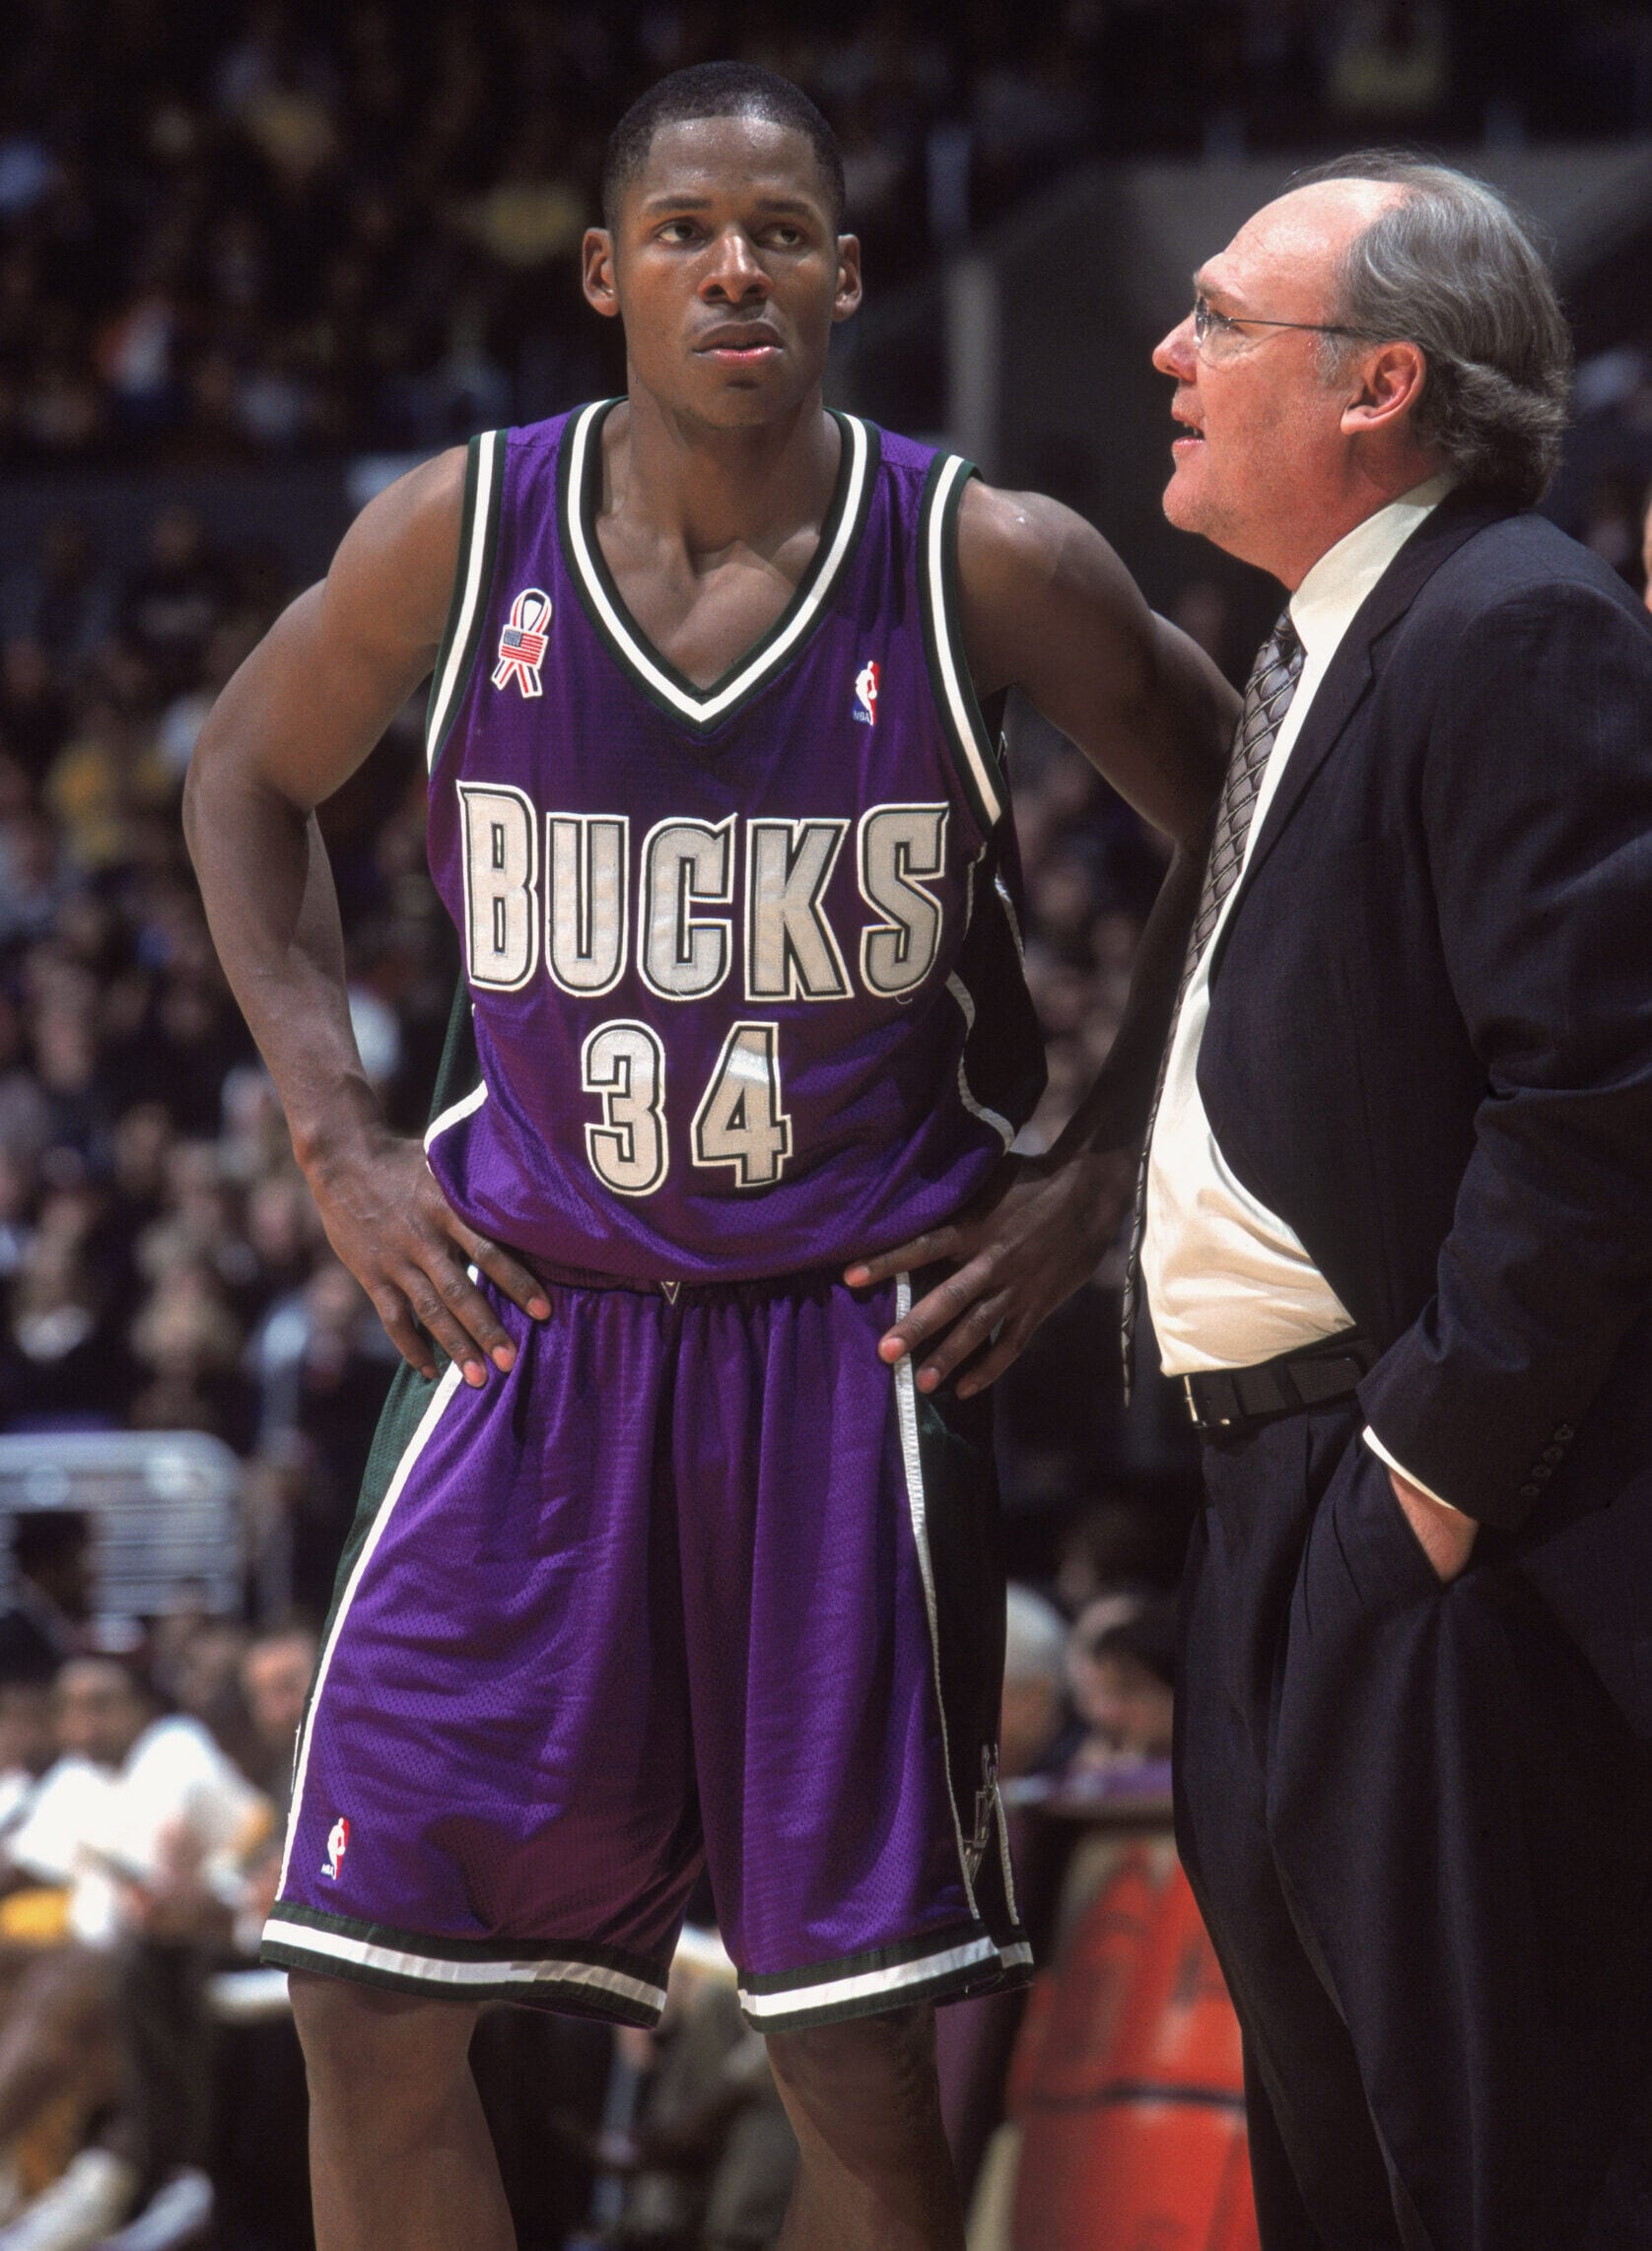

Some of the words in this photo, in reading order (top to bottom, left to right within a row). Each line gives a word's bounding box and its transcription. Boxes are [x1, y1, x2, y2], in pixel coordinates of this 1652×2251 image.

[853, 710, 870, 723] NBA
[456, 780, 949, 1000] BUCKS
[582, 1019, 792, 1196] 34
